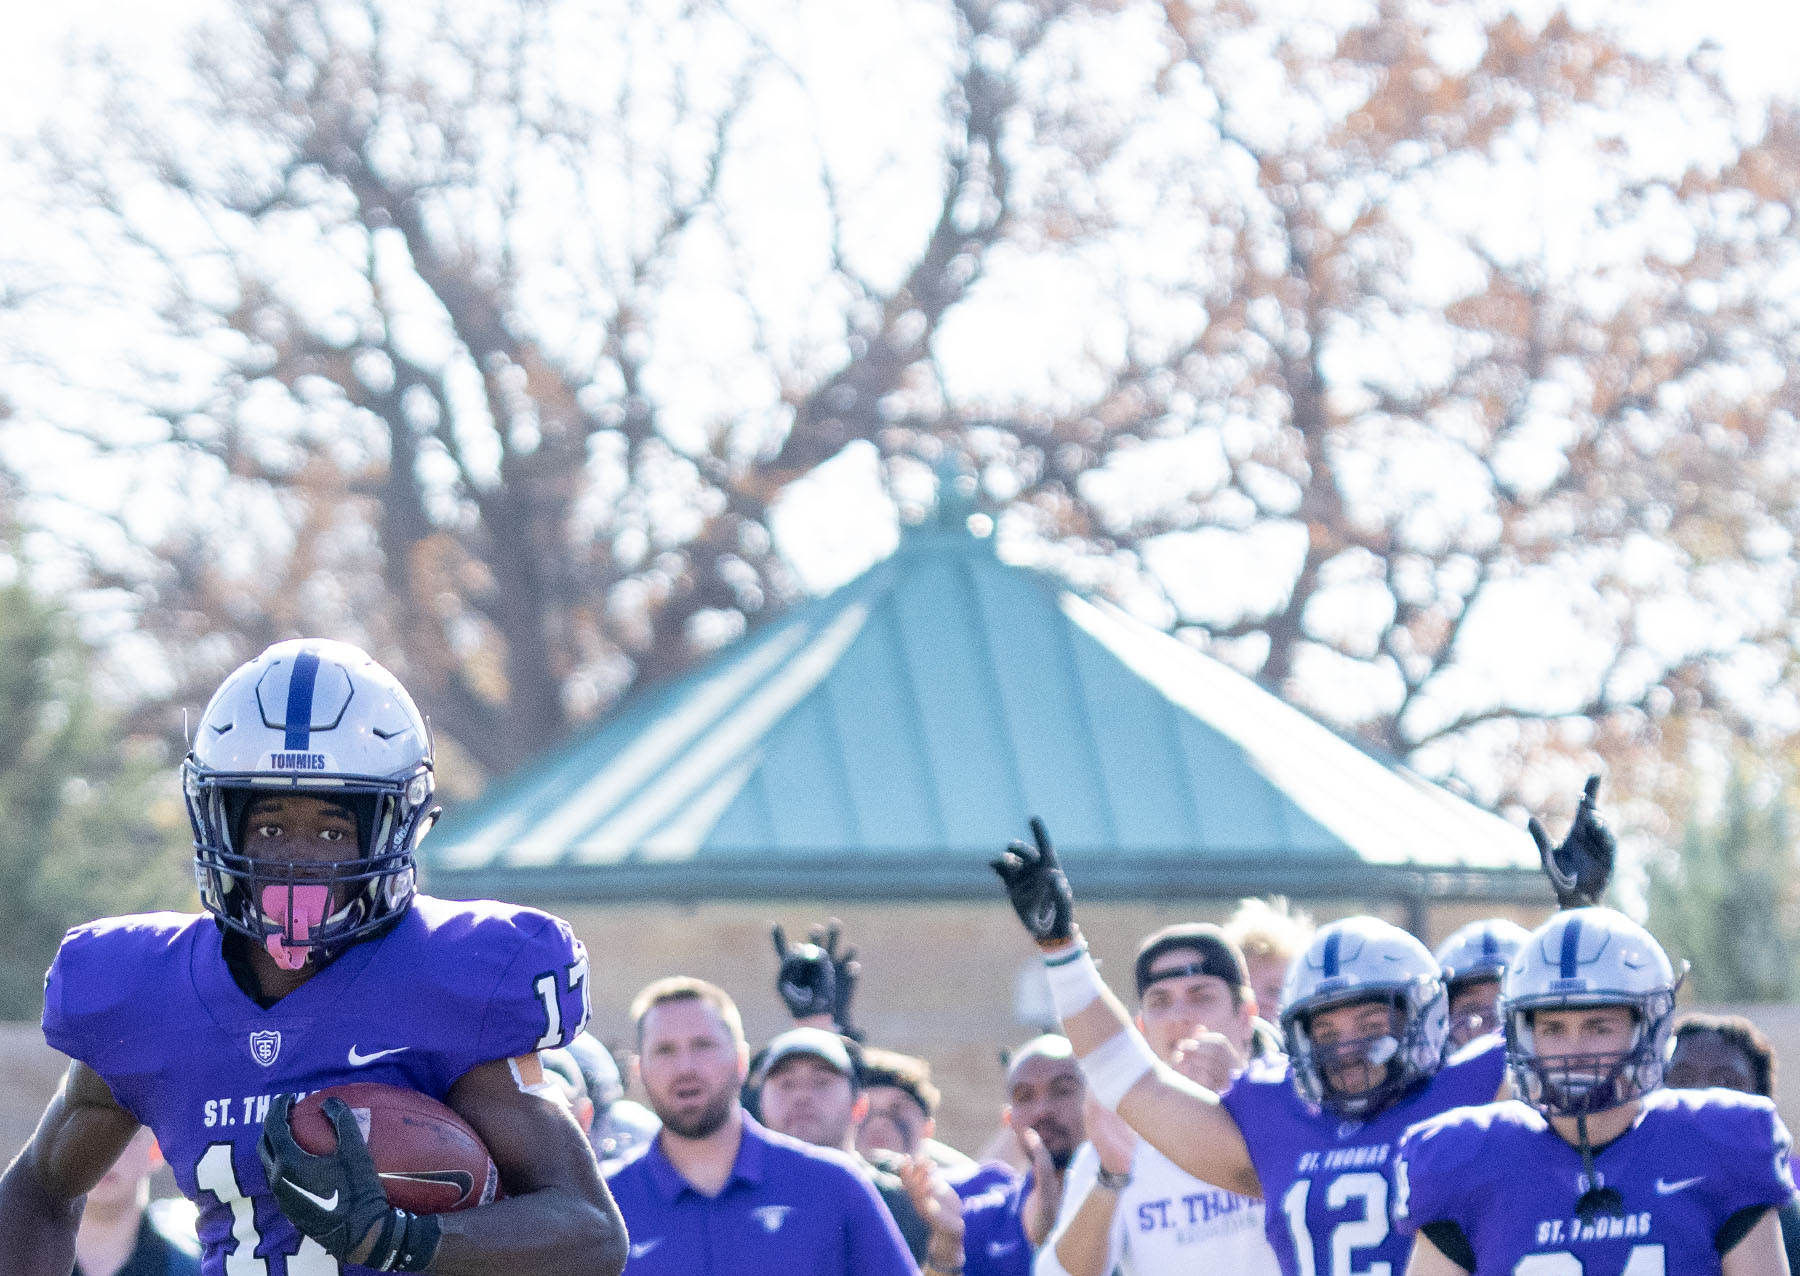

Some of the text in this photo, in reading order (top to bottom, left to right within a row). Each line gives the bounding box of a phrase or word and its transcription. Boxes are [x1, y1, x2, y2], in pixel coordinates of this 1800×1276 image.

[270, 753, 326, 770] TOMMIES
[533, 955, 589, 1050] 17
[204, 1098, 236, 1128] ST.
[1137, 1198, 1177, 1232] ST.
